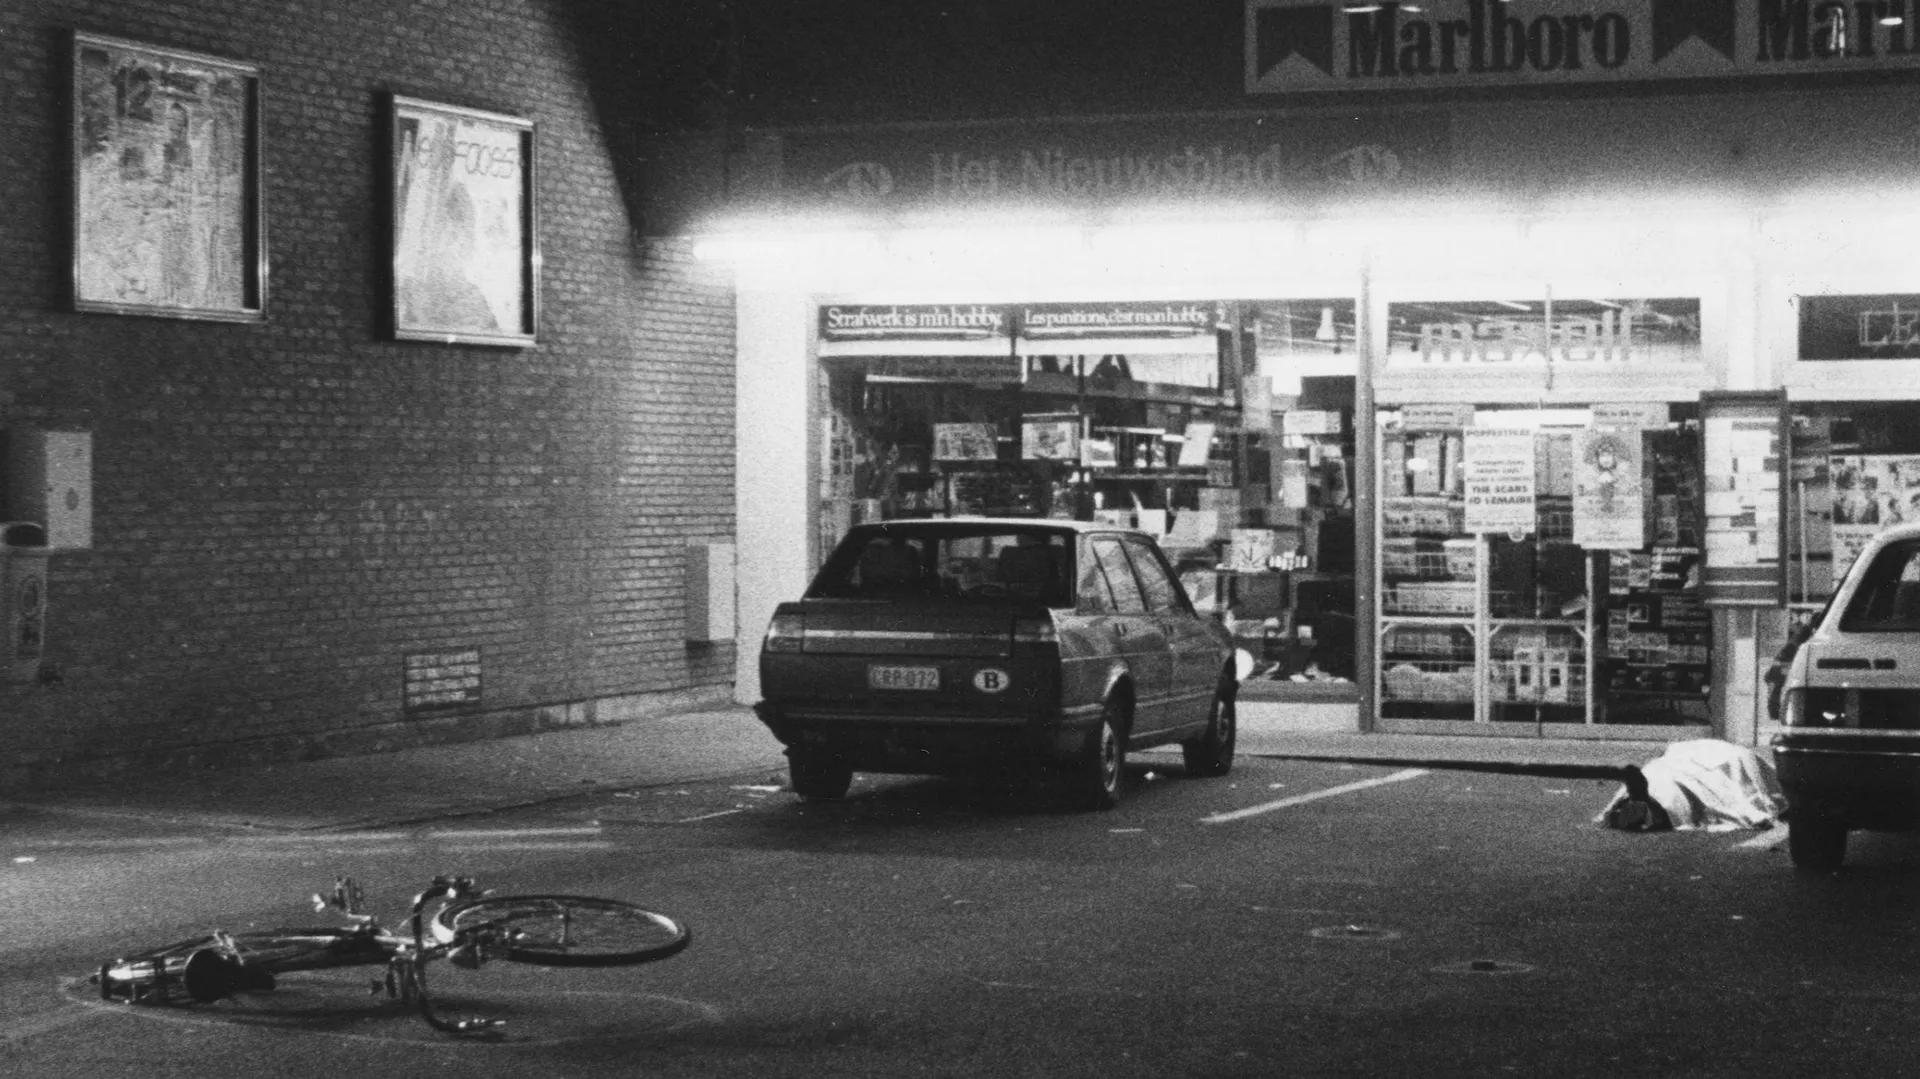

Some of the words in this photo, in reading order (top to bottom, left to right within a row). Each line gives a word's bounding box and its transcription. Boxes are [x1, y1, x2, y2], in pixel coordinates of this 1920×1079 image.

[1347, 0, 1630, 78] Marlboro
[930, 151, 1001, 198] Het
[1020, 143, 1283, 197] Nieuwsblad
[827, 306, 900, 328] Strafwerk
[904, 308, 917, 327] is
[1025, 309, 1045, 325] Les
[1135, 309, 1165, 323] mon
[984, 671, 1000, 689] B
